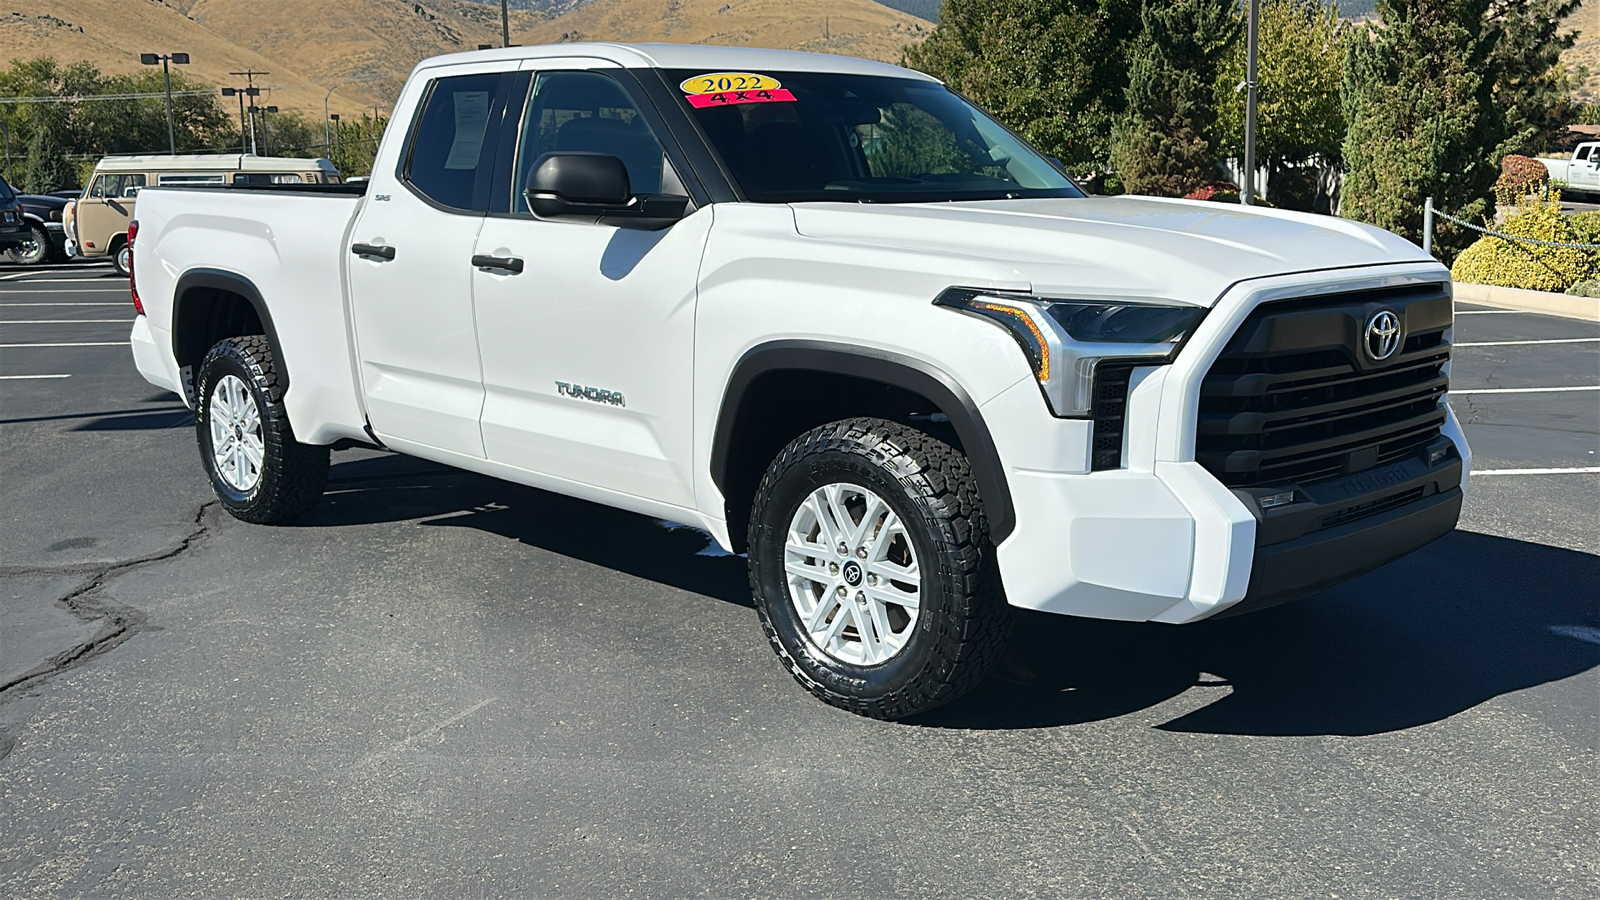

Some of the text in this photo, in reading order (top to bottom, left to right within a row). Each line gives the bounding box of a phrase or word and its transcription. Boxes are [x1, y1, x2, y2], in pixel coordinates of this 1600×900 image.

[701, 76, 762, 93] 2022
[554, 380, 626, 408] TUNDRA
[1335, 464, 1412, 495] TUNDRA
